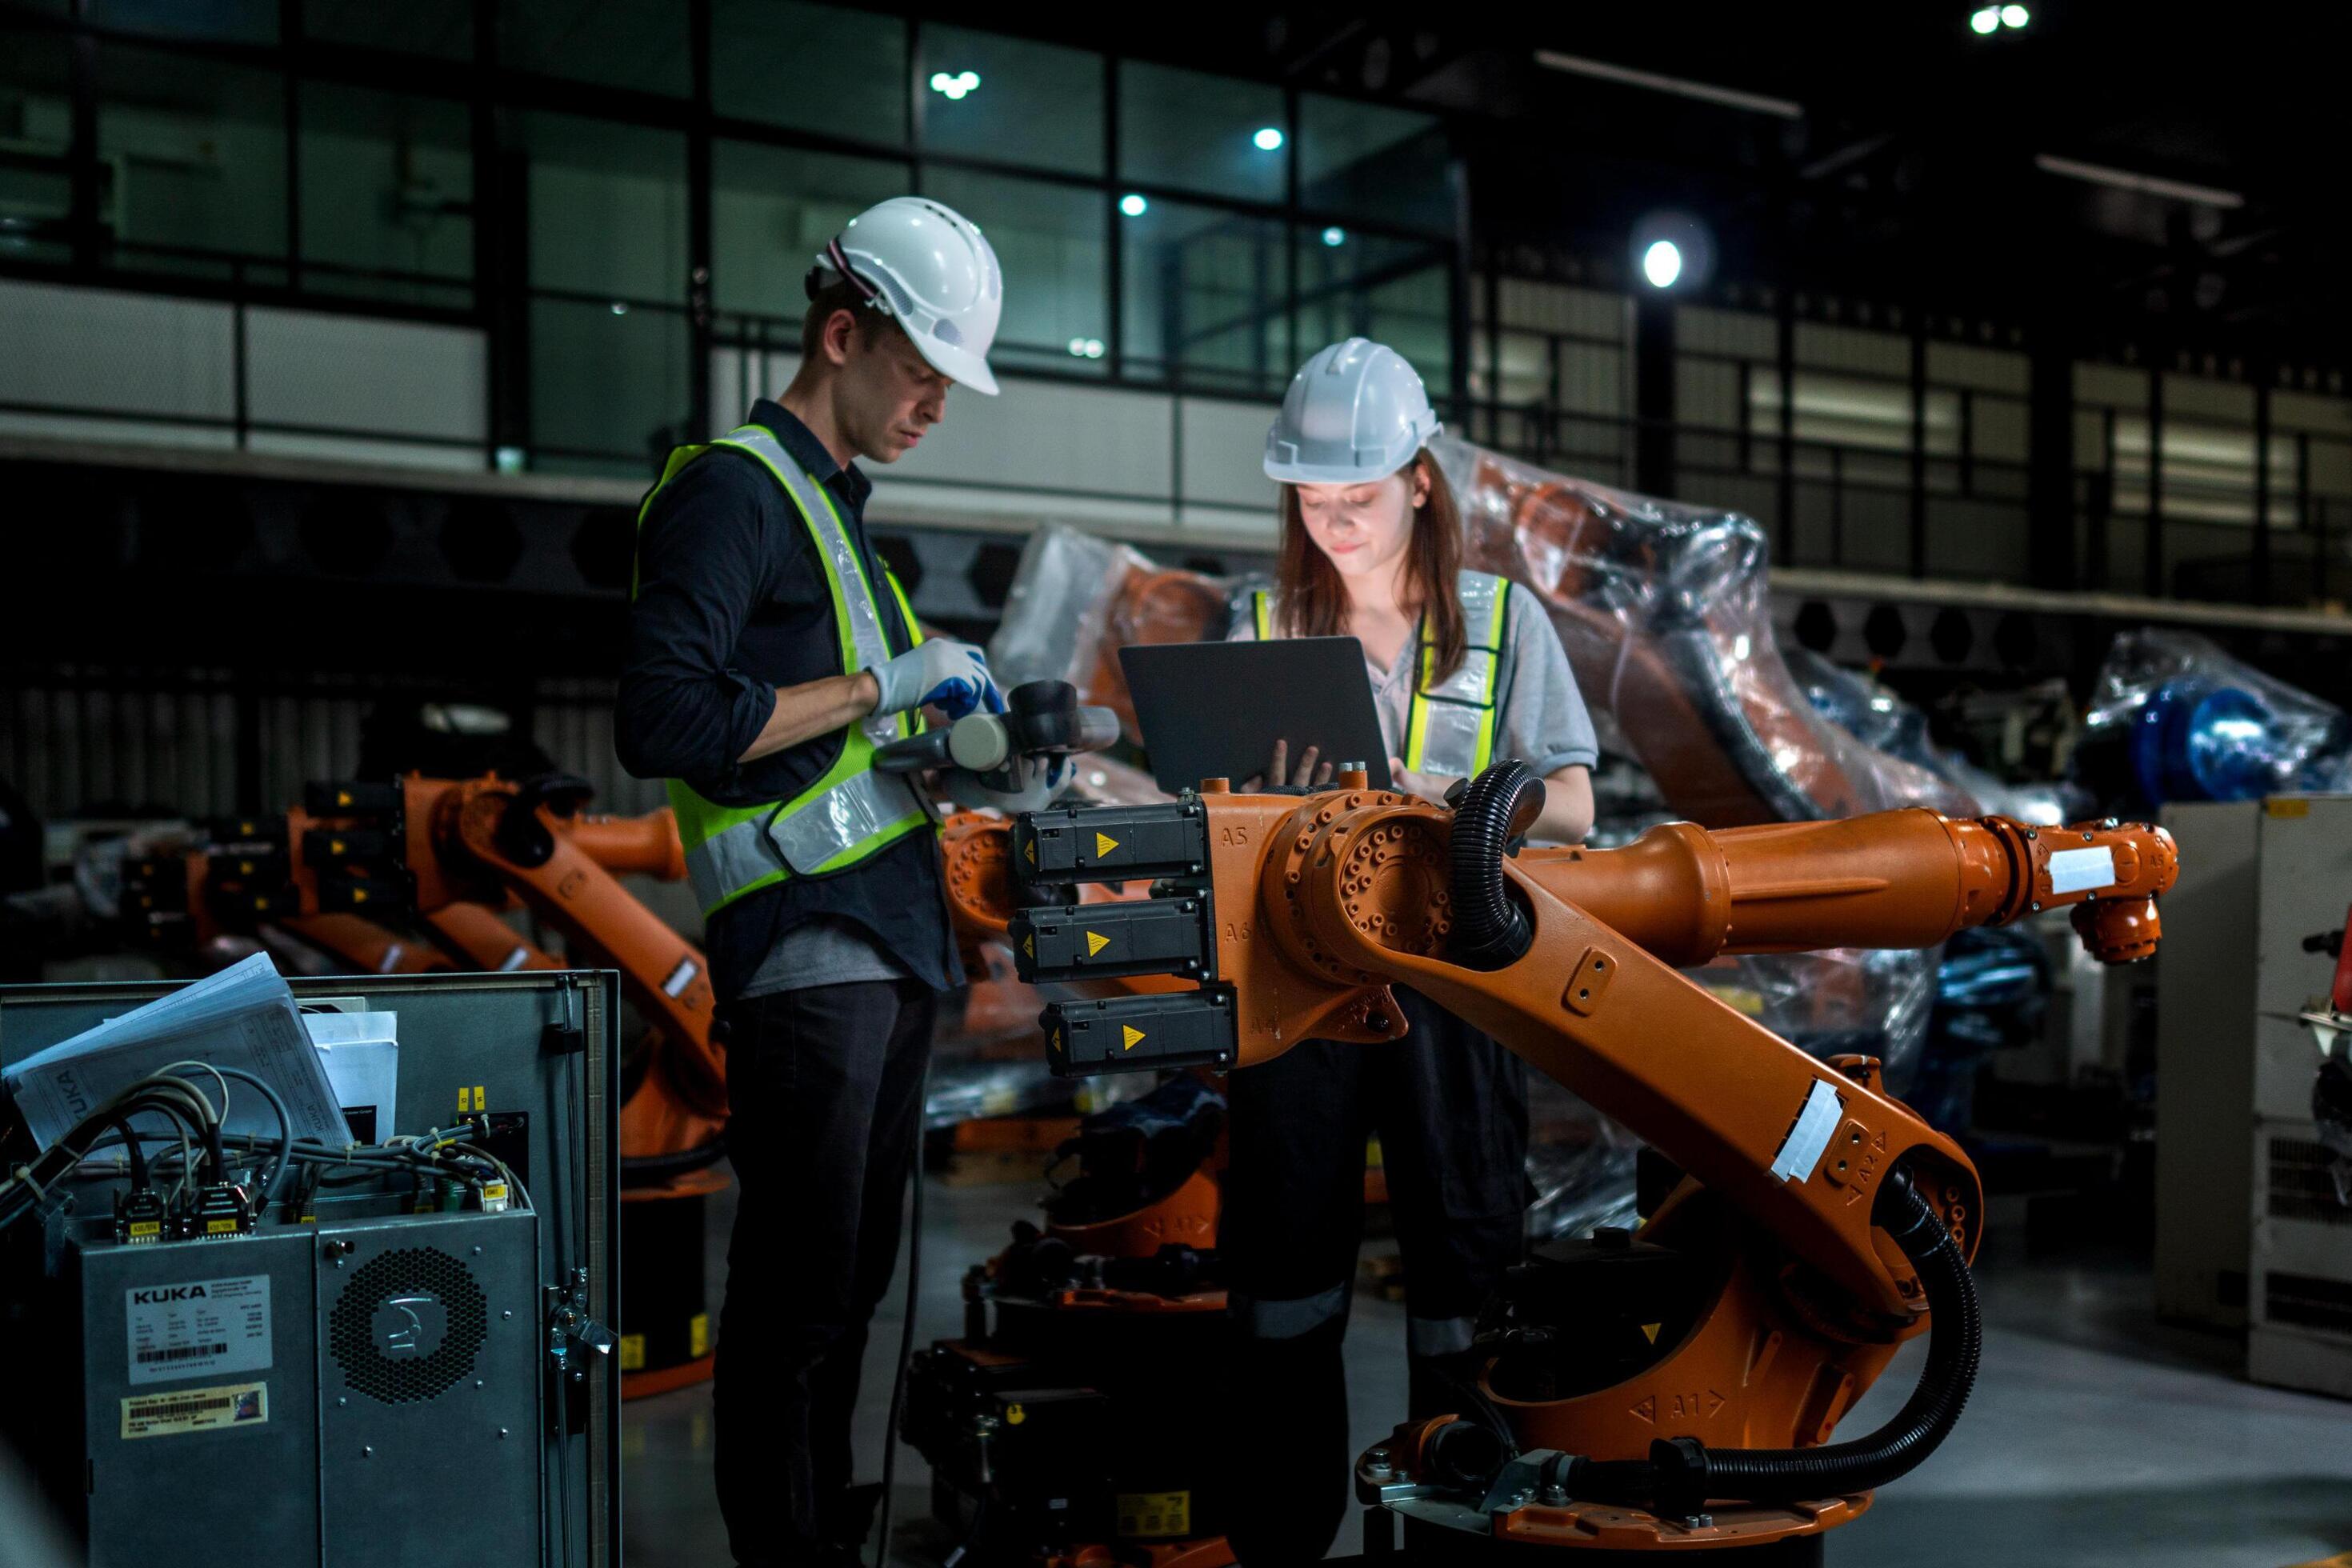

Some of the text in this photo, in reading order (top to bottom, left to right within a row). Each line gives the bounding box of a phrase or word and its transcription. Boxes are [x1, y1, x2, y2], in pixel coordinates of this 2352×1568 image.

[1221, 826, 1247, 846] A5
[1224, 922, 1251, 943] A6
[56, 1070, 88, 1118] UKA
[1857, 1154, 1878, 1184] A2
[134, 1285, 206, 1305] KUKA
[1670, 1393, 1699, 1419] A1
